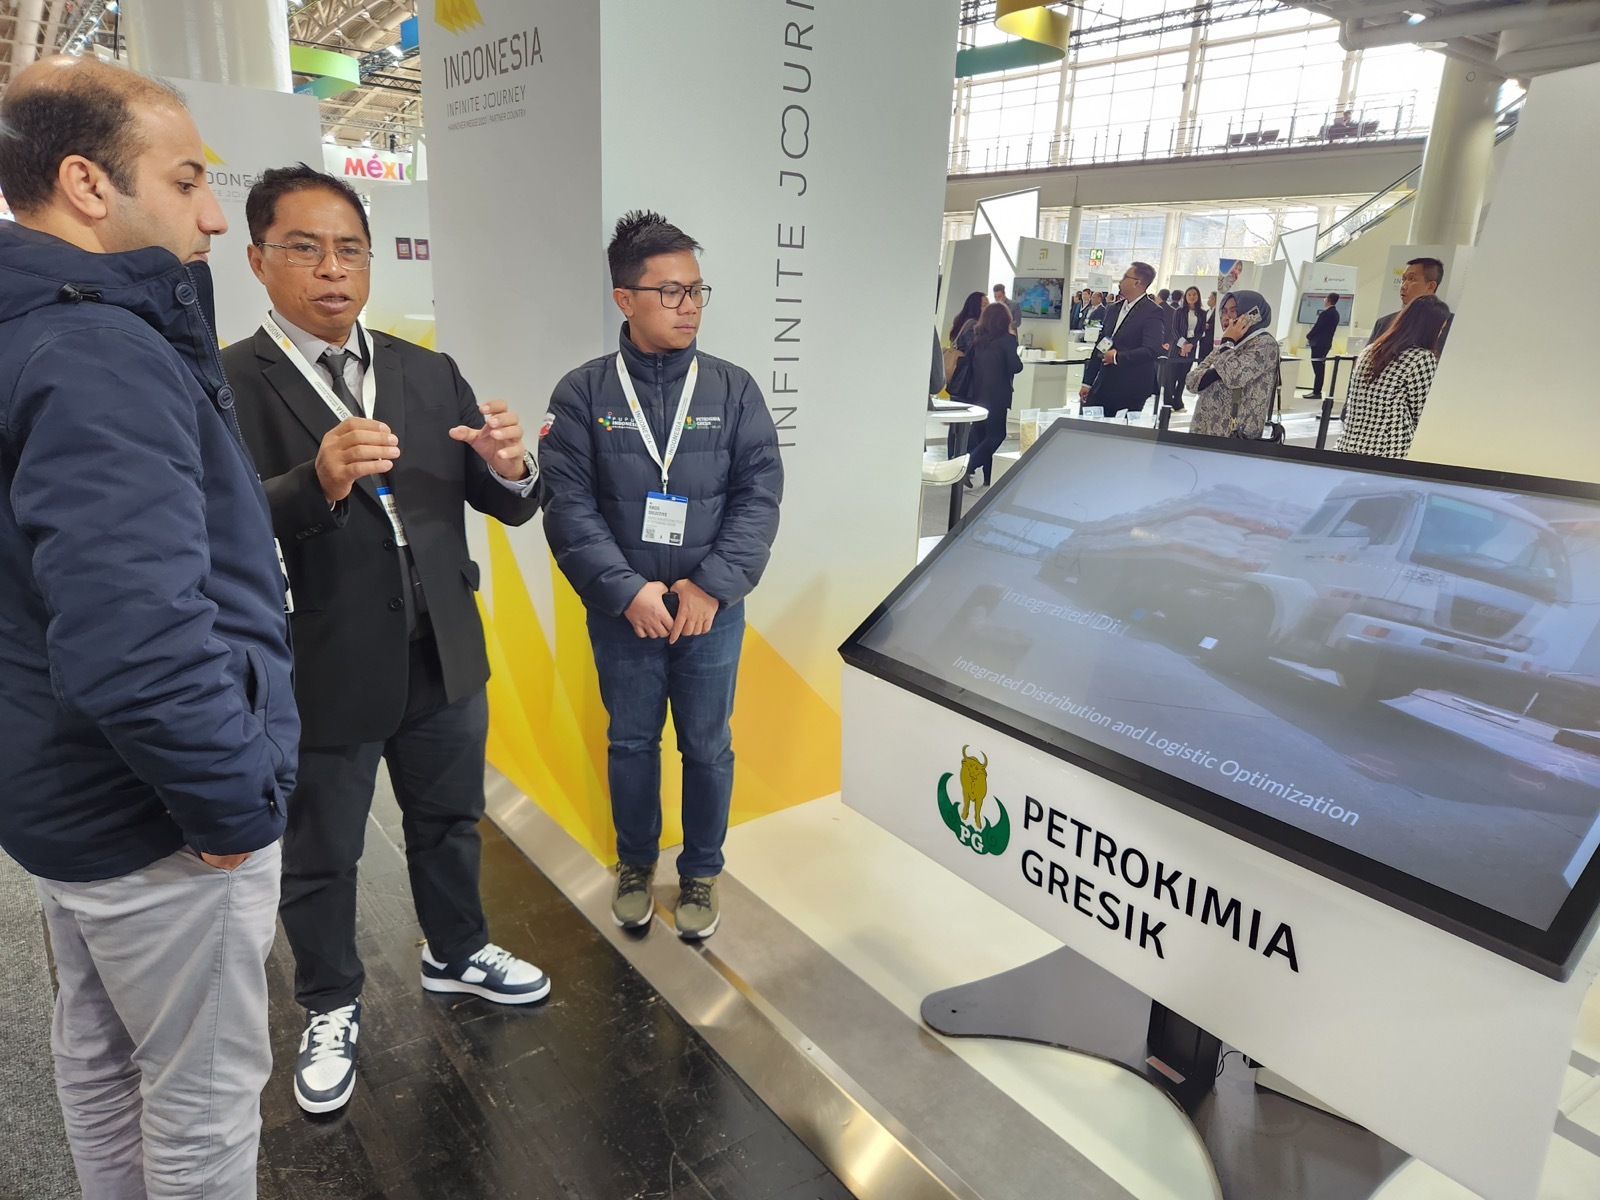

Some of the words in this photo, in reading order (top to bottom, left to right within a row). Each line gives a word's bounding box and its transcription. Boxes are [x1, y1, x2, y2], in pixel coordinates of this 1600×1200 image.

[444, 27, 543, 89] INDONESIA
[447, 96, 480, 118] INFINITE
[483, 85, 526, 110] JOURNEY
[772, 223, 805, 448] INFINITE
[1002, 585, 1096, 626] Integrated
[953, 655, 1024, 691] Integrated
[1021, 682, 1112, 728] Distribution
[1112, 720, 1149, 741] and
[1145, 730, 1218, 769] Logistic
[1219, 759, 1360, 827] Optimization
[960, 824, 984, 853] PG
[1021, 849, 1167, 960] GRESIK
[1023, 795, 1299, 973] PETROKIMIA
